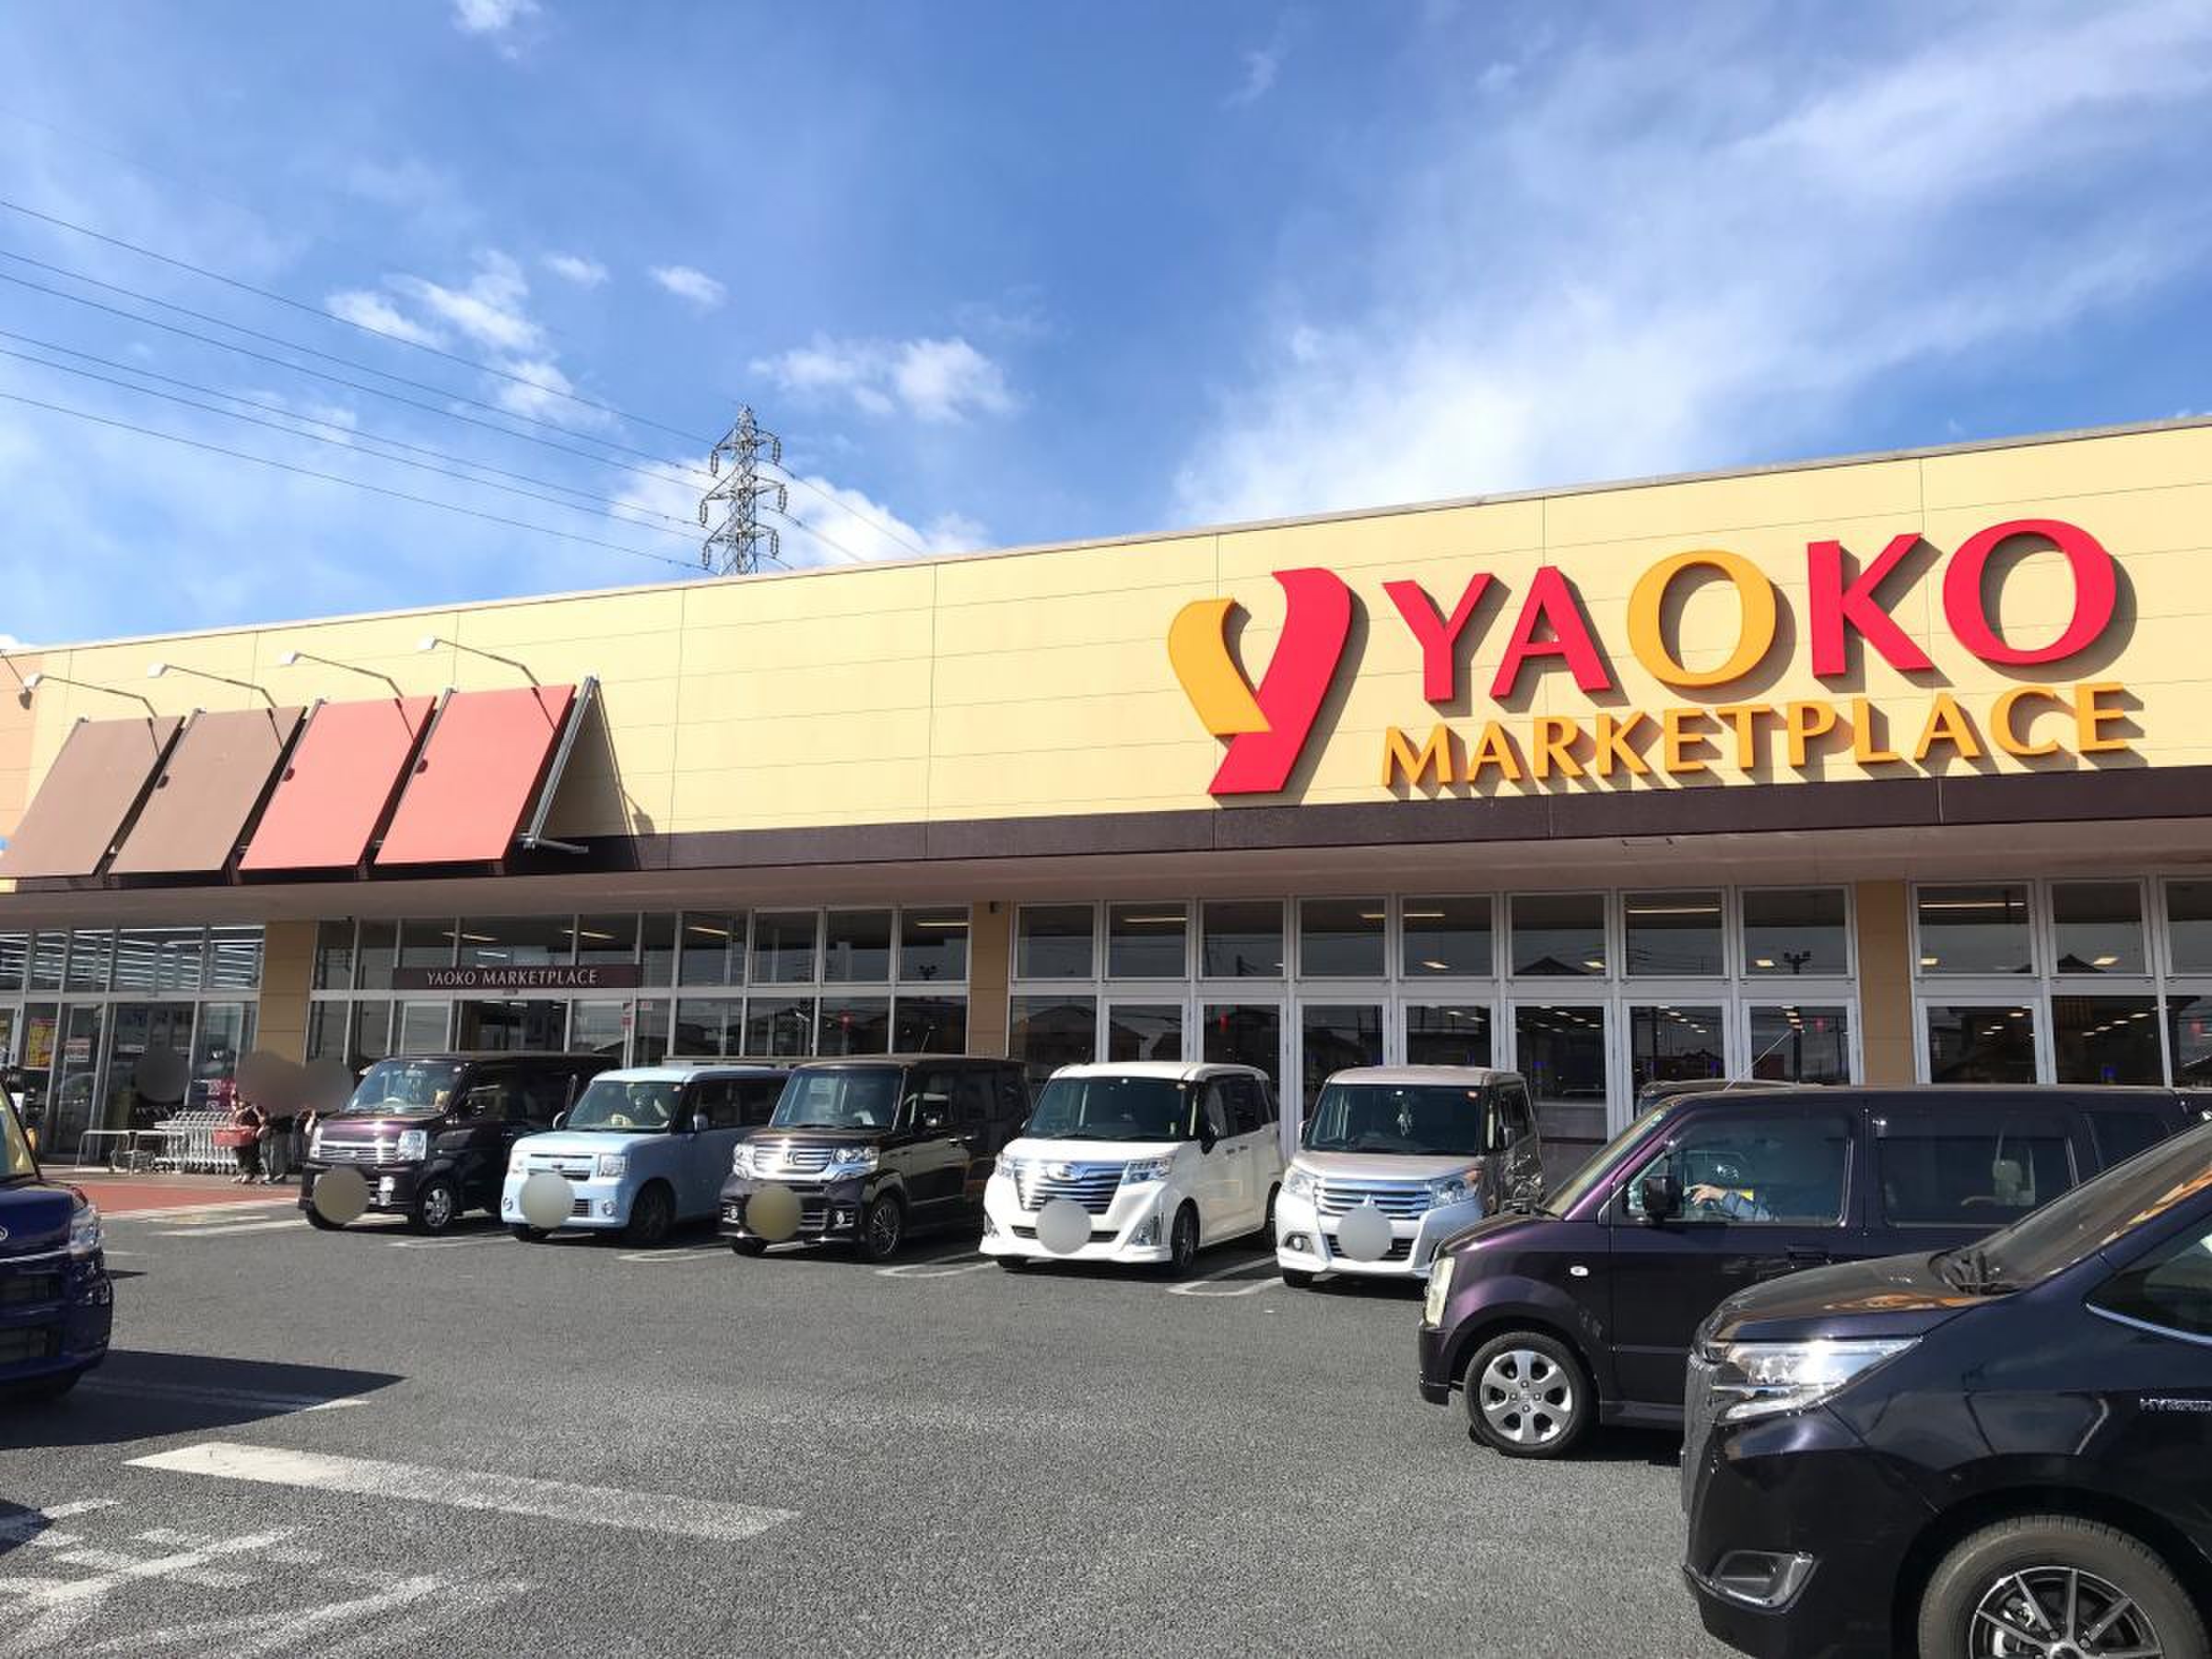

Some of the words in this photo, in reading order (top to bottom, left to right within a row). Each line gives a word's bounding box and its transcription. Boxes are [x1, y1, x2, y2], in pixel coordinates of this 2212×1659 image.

[1382, 519, 2119, 703] YAOKO
[1382, 682, 2127, 789] MARKETPLACE
[427, 971, 477, 986] YAOKO
[482, 970, 598, 985] MARKETPLACE
